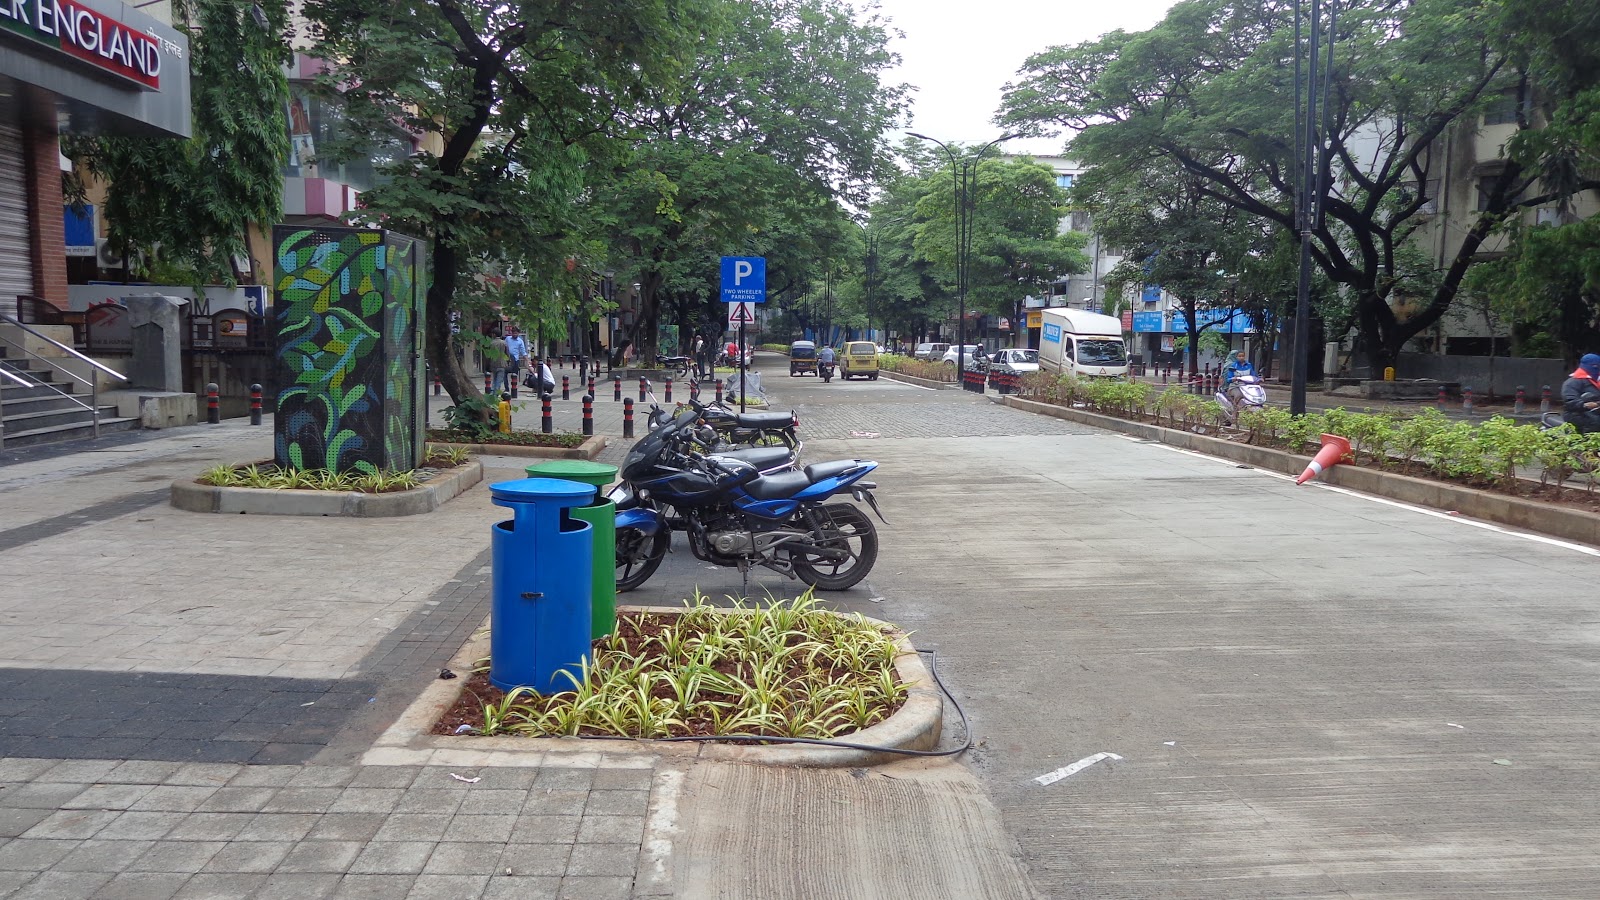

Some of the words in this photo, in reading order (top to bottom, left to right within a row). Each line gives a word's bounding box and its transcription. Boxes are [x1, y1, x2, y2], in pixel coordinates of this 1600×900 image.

[0, 0, 30, 25] R
[38, 0, 161, 77] ENGLAND
[735, 261, 753, 286] P
